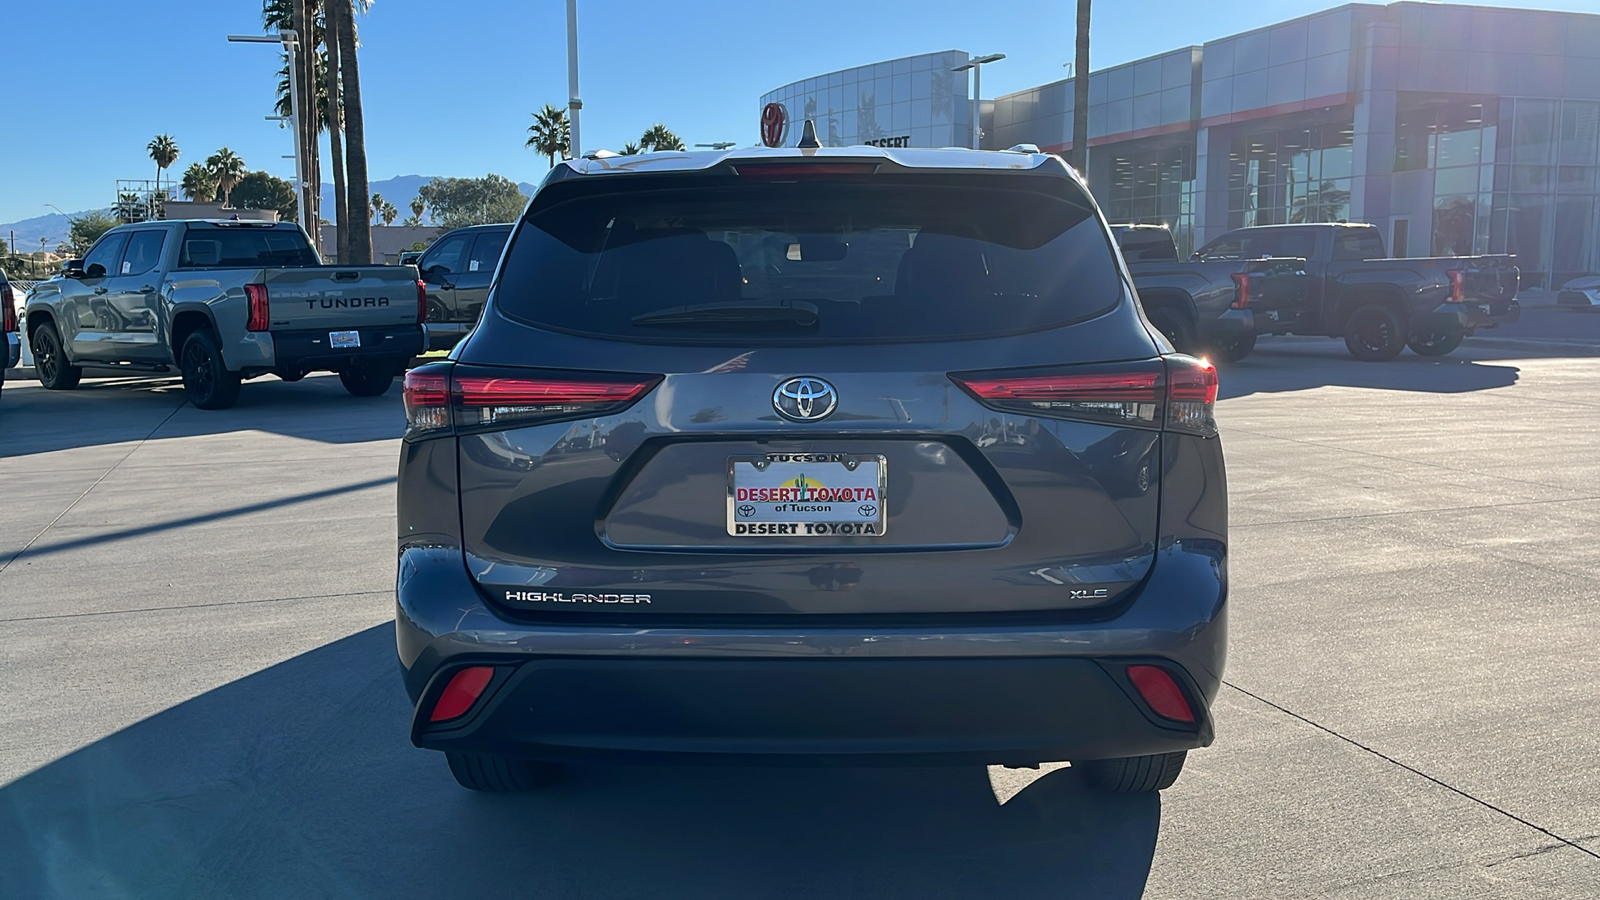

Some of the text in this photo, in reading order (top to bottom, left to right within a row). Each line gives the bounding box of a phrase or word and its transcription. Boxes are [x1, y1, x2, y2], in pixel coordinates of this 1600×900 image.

[305, 297, 390, 309] TUNDRA
[767, 454, 842, 463] TUCSON
[737, 488, 876, 501] DESERT TOYOTA
[775, 504, 832, 512] of Tucson
[735, 523, 875, 534] DESERT TOYOTA
[505, 591, 652, 604] HIGHLANDER
[1070, 589, 1108, 599] XLE
